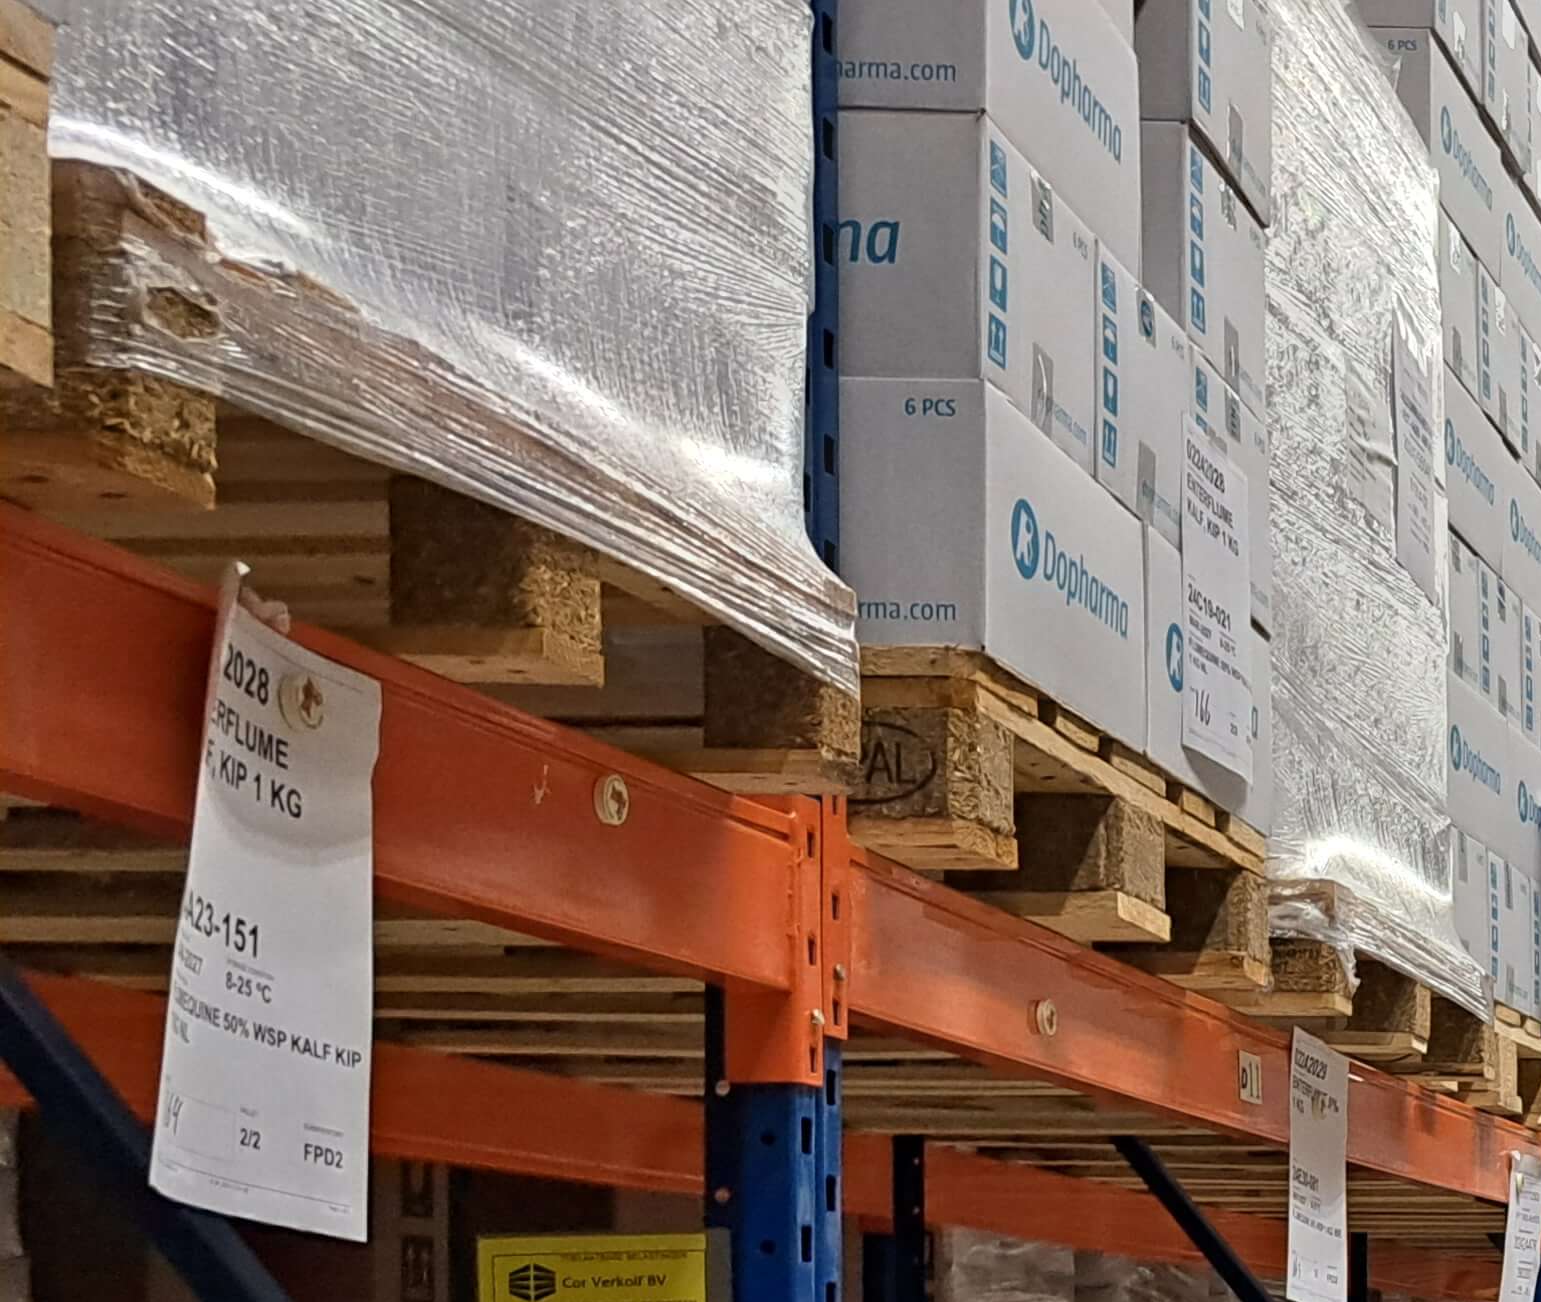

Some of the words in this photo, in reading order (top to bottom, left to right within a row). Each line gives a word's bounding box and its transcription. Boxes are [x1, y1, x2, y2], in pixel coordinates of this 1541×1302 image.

[1039, 19, 1122, 165] Dopharma
[1452, 129, 1493, 211] Dopharma
[904, 397, 917, 417] 6
[922, 398, 957, 418] PCS
[1043, 530, 1130, 641] Dopharma
[219, 750, 248, 790] KIP
[253, 773, 262, 802] 1
[270, 779, 303, 819] KG
[1461, 742, 1501, 796] Dopharma
[225, 971, 253, 998] 8-25
[223, 1011, 250, 1039] 50%
[253, 1021, 288, 1048] WSP
[290, 1034, 332, 1062] KALF
[335, 1046, 362, 1069] KIP
[239, 1127, 262, 1151] 2/2
[303, 1142, 345, 1170] FPD2
[562, 1276, 587, 1289] Cor
[647, 1274, 667, 1287] BV
